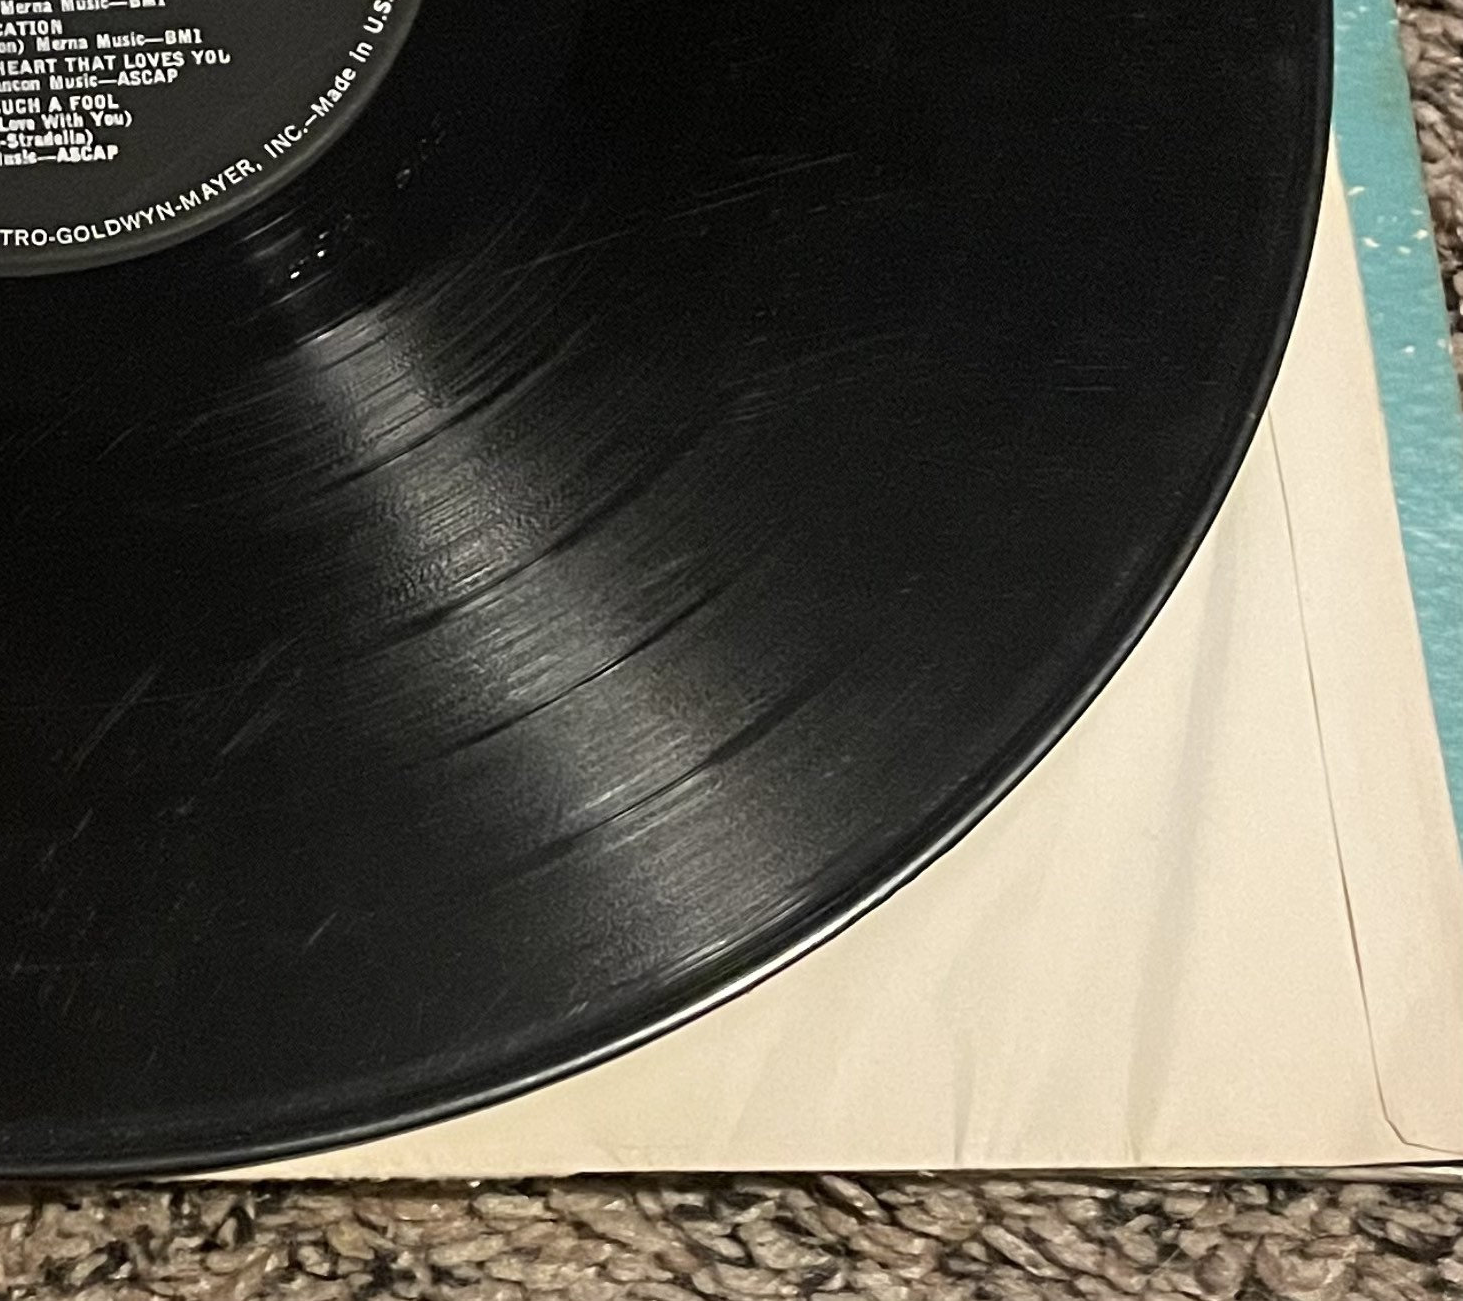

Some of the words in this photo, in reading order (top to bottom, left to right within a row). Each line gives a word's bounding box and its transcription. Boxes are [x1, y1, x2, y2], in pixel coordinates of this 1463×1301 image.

[65, 55, 117, 73] THAT
[123, 51, 185, 70] LOVES
[191, 49, 231, 66] YOU
[48, 96, 63, 113] A
[69, 93, 120, 111] FOOL
[41, 112, 84, 130] With
[90, 110, 133, 128] You)
